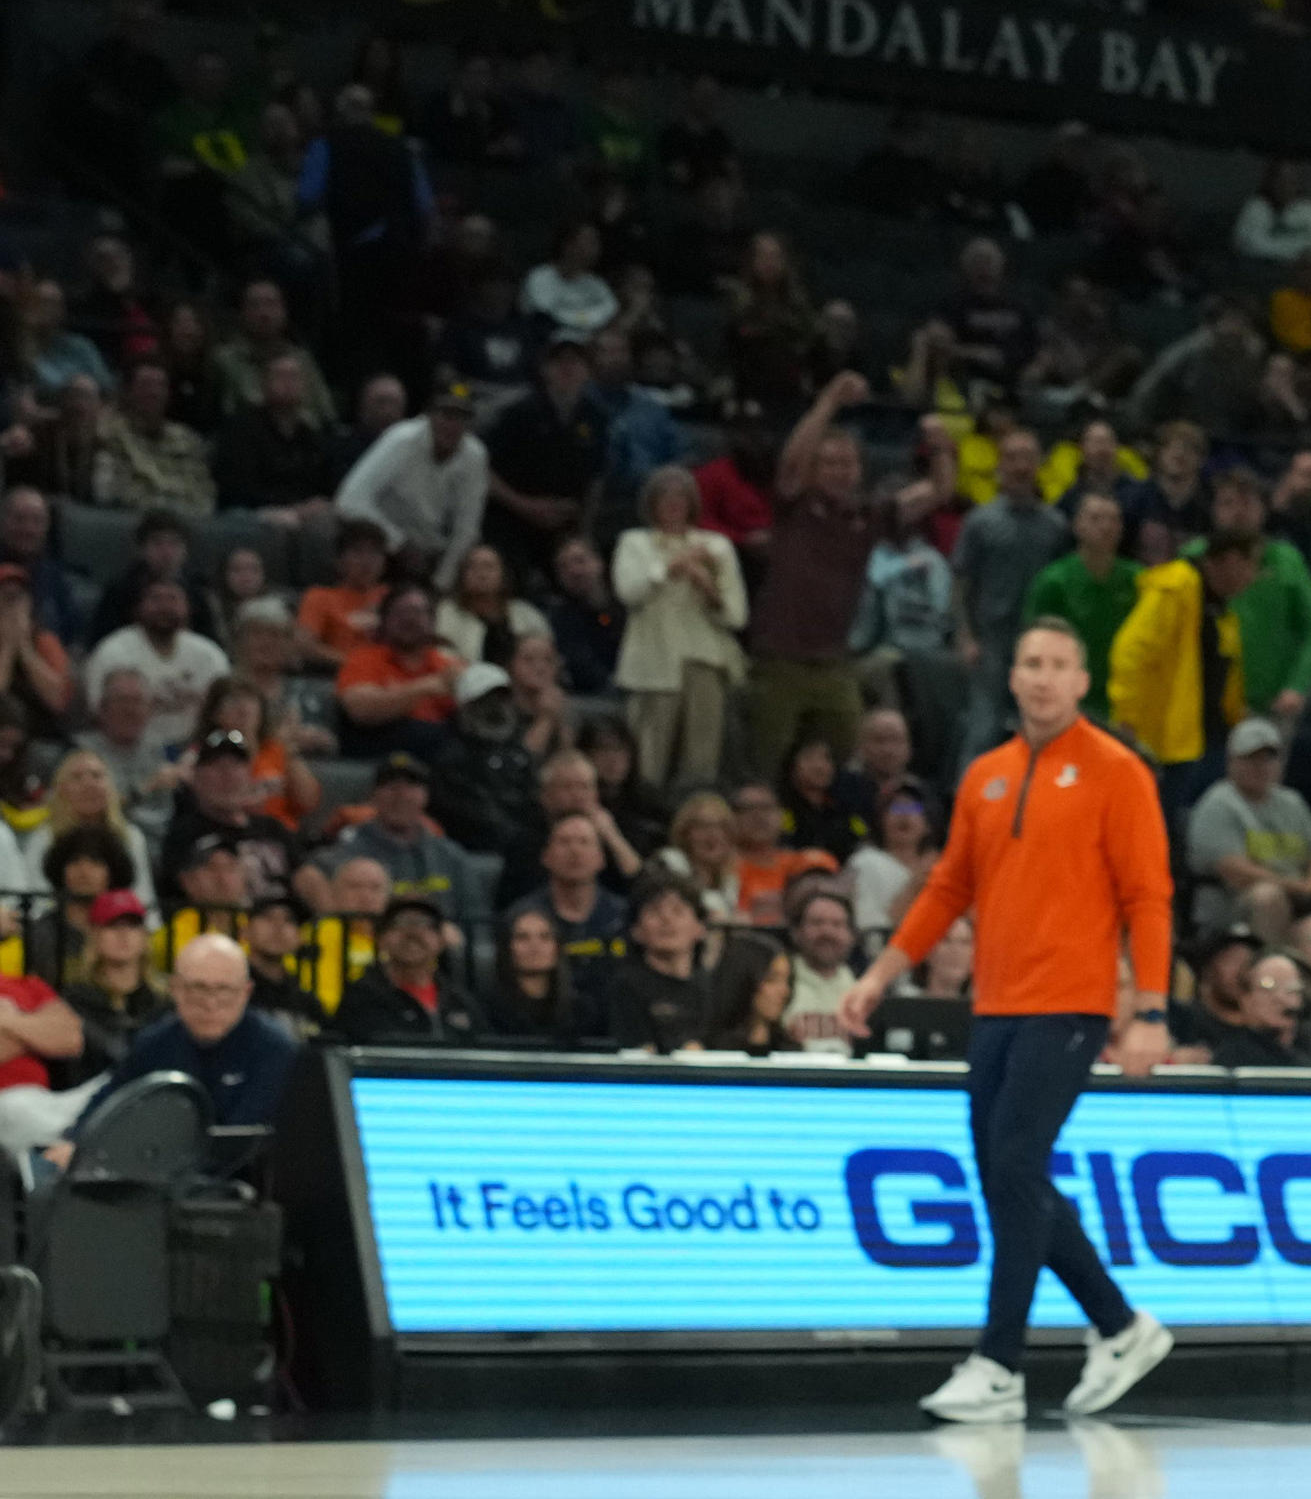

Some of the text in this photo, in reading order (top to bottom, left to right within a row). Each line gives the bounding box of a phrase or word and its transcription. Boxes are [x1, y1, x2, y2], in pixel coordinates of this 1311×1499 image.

[1098, 27, 1230, 108] BAY
[430, 1180, 822, 1232] It Feels Good to
